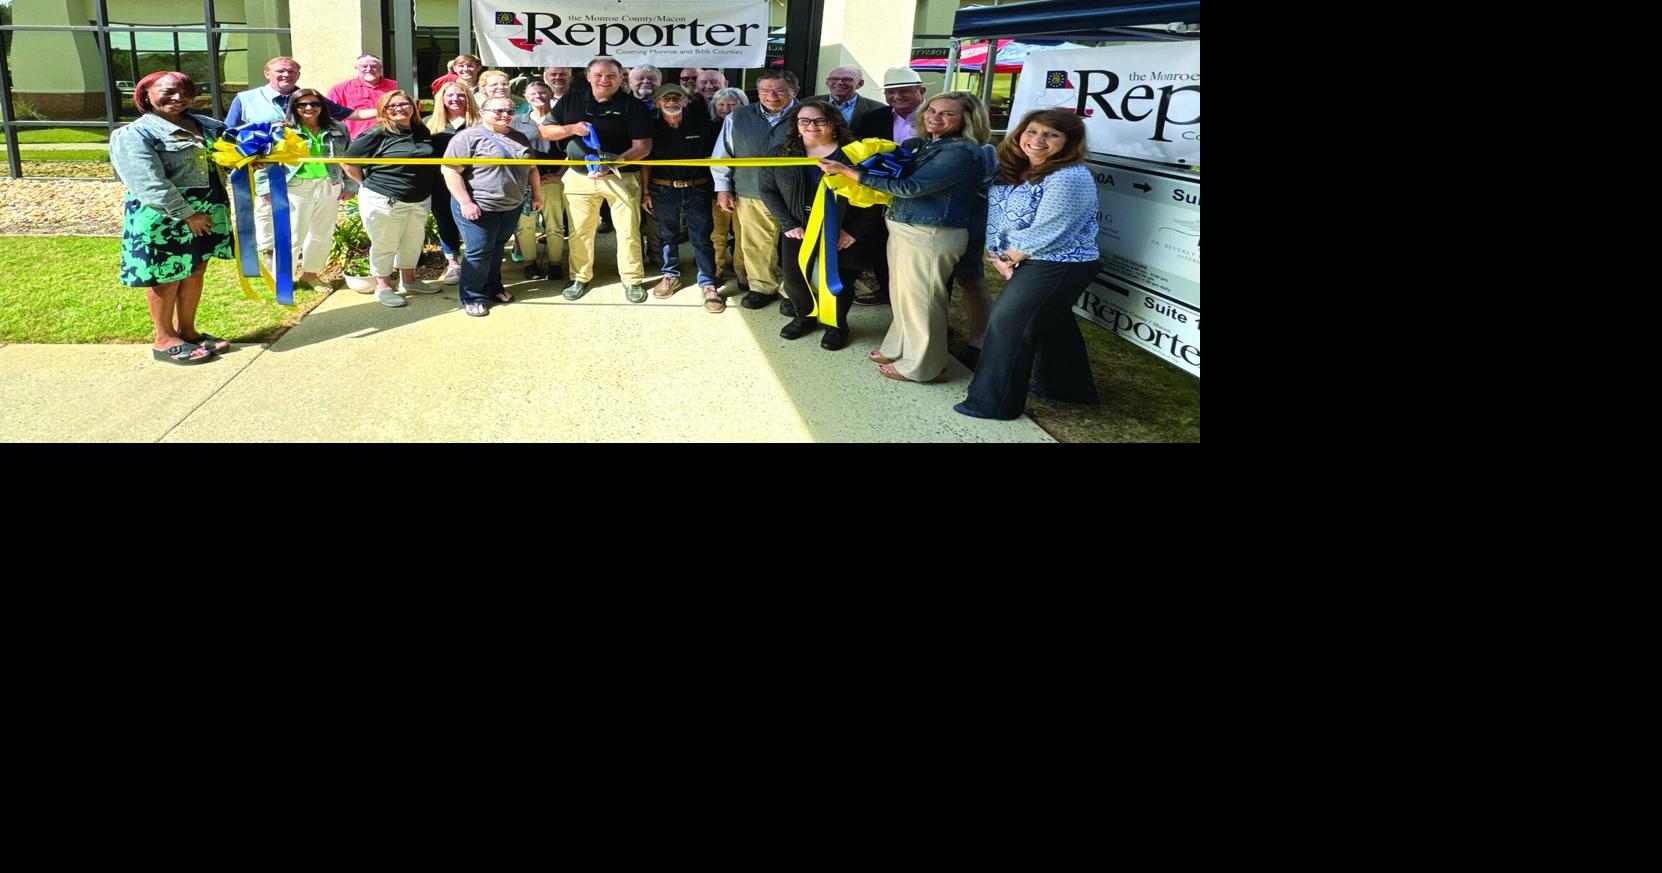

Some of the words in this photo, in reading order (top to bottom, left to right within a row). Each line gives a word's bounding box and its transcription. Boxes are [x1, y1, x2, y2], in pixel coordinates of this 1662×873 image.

[621, 14, 686, 23] County/Macon
[521, 12, 760, 57] Reporter
[615, 48, 647, 56] Covering
[1128, 71, 1147, 81] the
[1150, 71, 1200, 81] Monroe
[1073, 69, 1200, 143] Rep
[1095, 173, 1115, 187] 0A
[1143, 296, 1188, 324] Suite
[1080, 291, 1200, 368] Reporte
